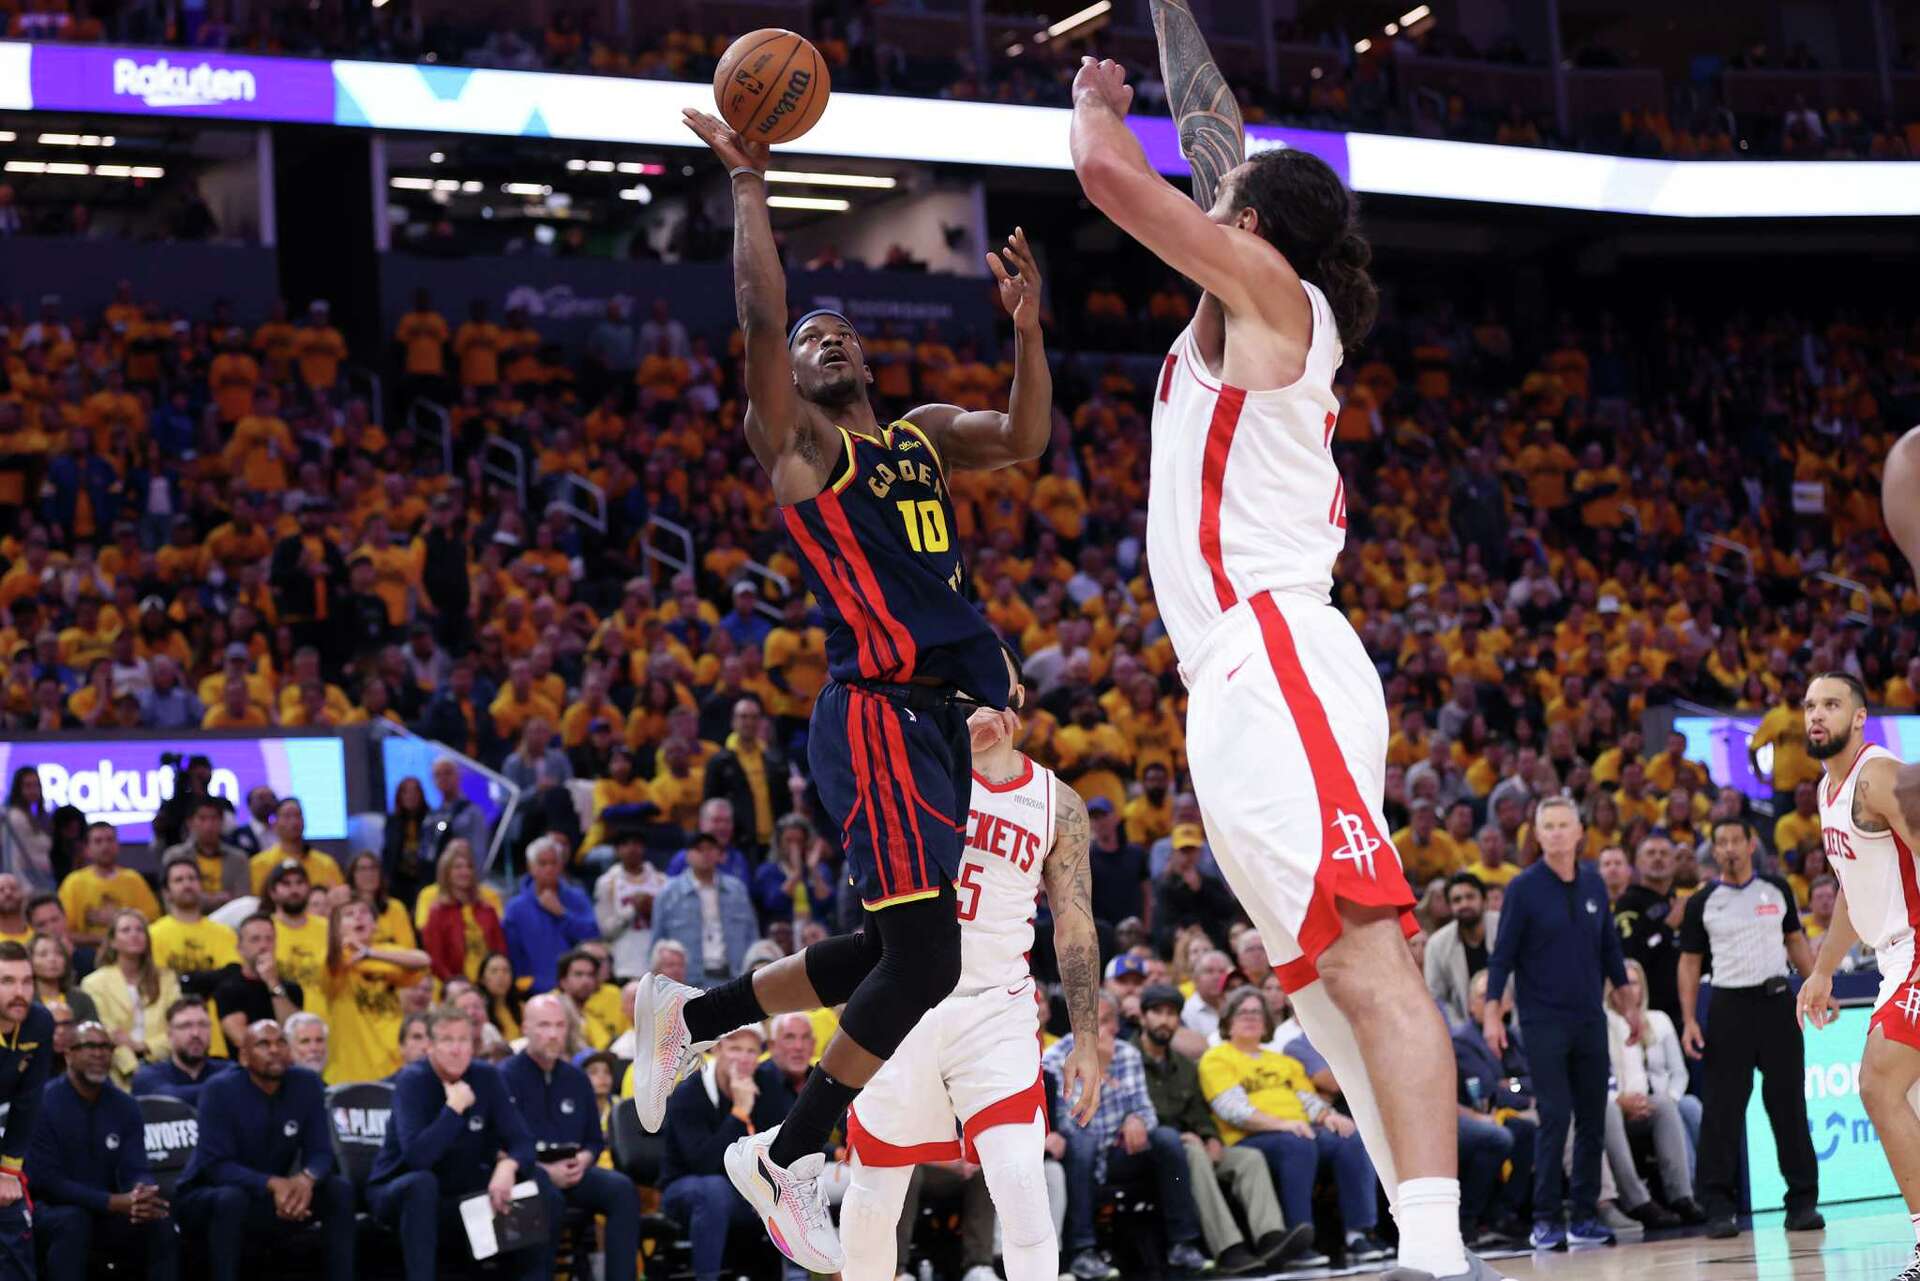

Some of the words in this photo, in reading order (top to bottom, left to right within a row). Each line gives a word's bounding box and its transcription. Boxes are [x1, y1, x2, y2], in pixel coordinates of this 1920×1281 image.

[113, 58, 256, 105] Rakuten
[758, 69, 811, 134] Wilson
[896, 499, 949, 553] 10
[37, 759, 240, 818] Rakutn
[964, 809, 1041, 873] CKETS
[956, 862, 985, 921] 5
[144, 1119, 198, 1150] AYOFFS
